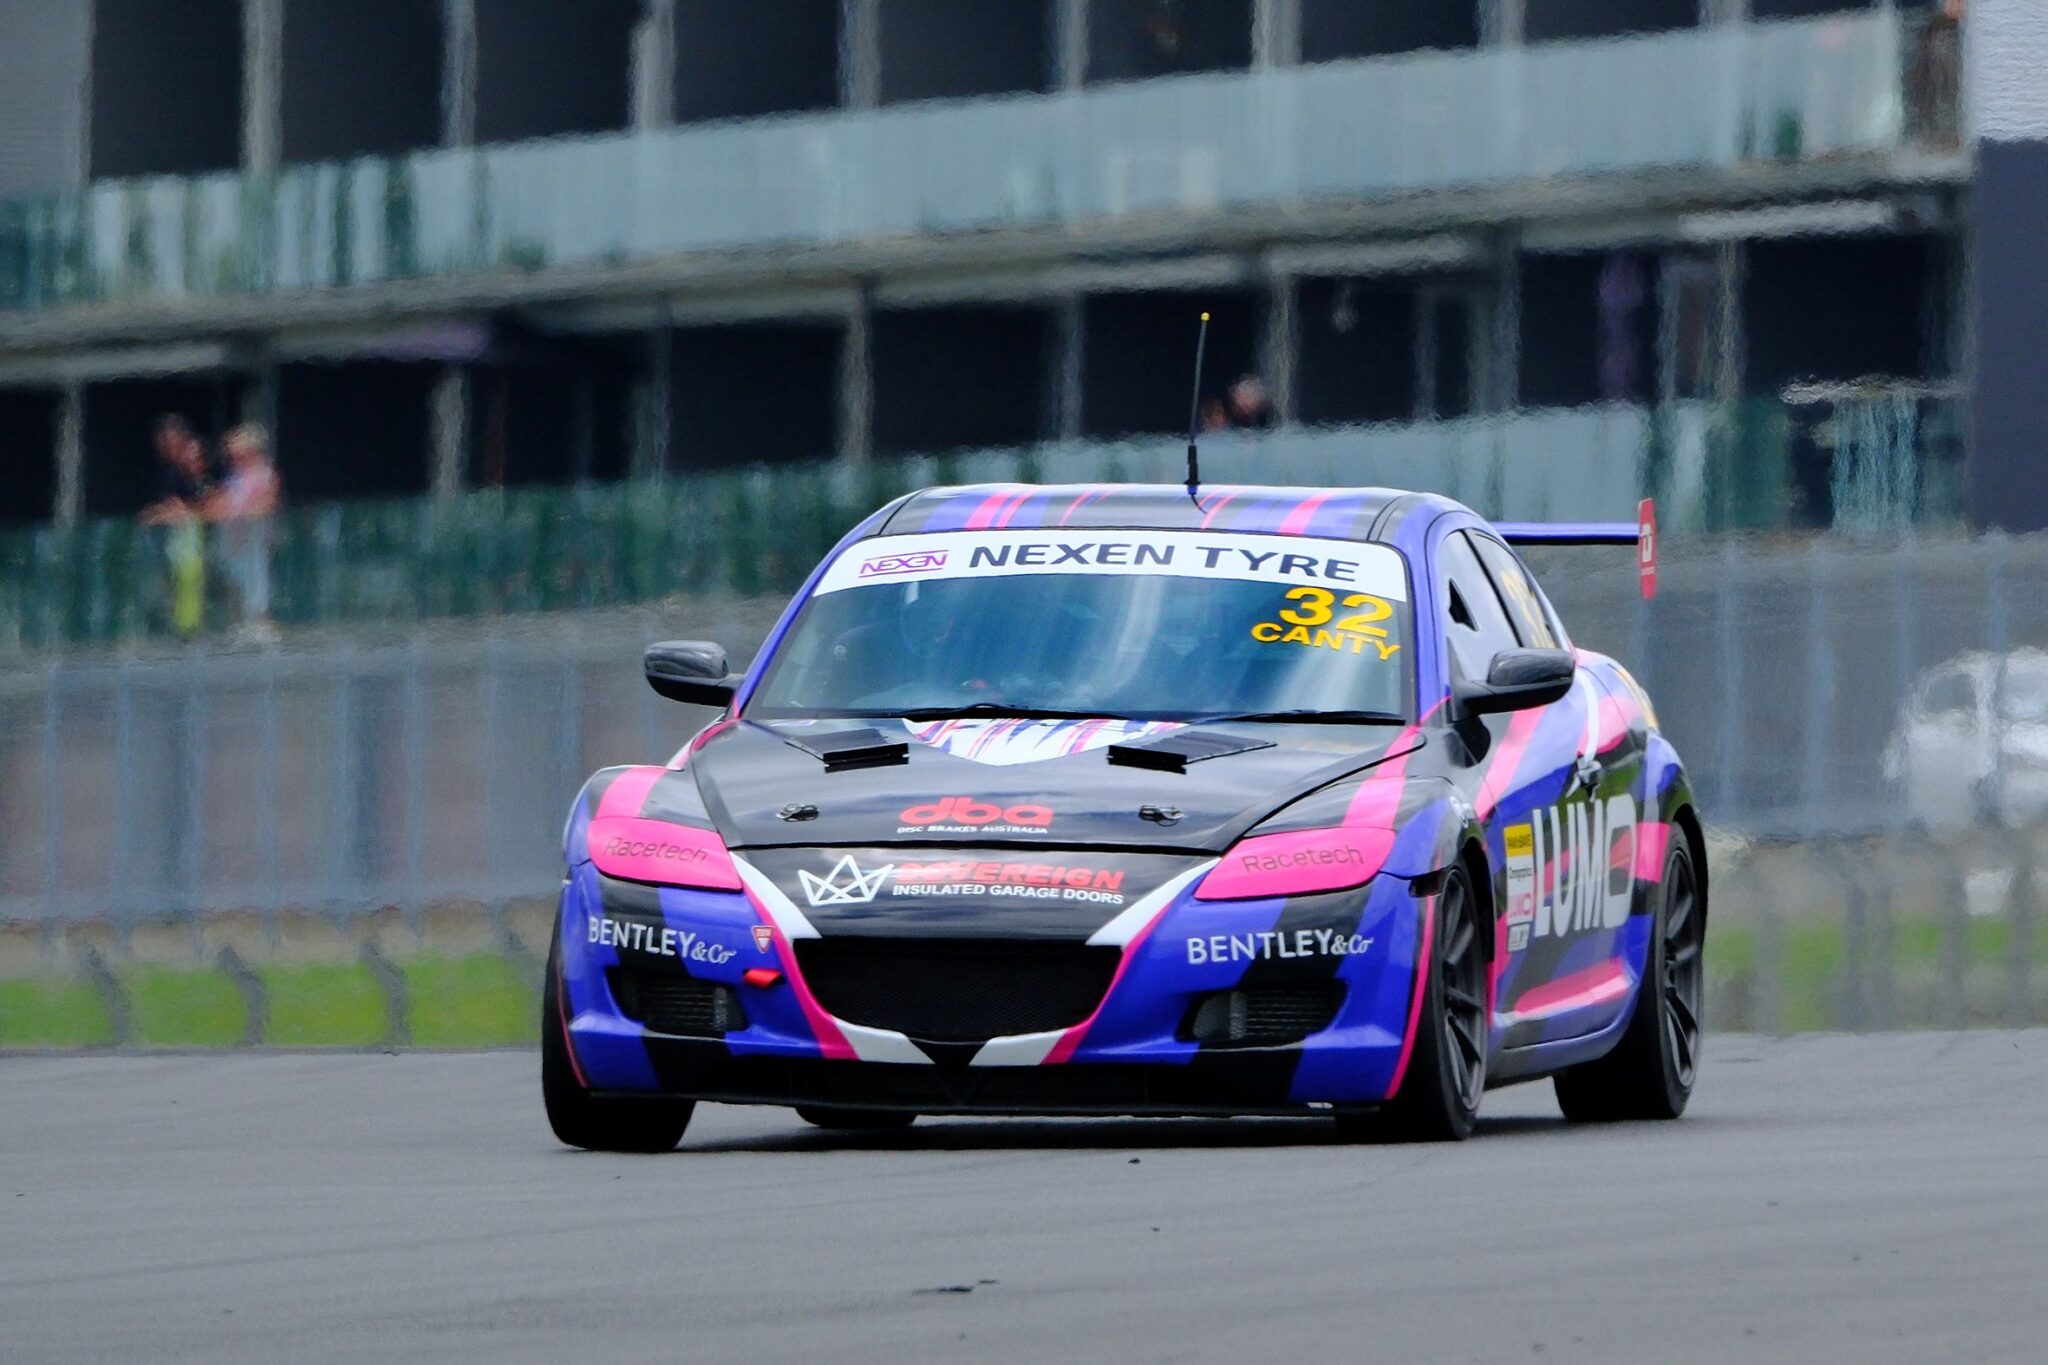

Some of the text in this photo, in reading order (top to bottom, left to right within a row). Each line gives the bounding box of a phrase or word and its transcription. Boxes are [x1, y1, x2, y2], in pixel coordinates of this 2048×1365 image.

[860, 552, 948, 575] NEXEN
[968, 543, 1360, 583] NEXEN TYRE
[1279, 586, 1393, 638] 32
[1251, 622, 1401, 661] CANTY
[900, 796, 1053, 826] dba
[897, 824, 1049, 834] DISC BRAKES AUSTRALIA
[604, 836, 709, 864] Racetech
[1242, 845, 1364, 873] Racetech
[1532, 793, 1637, 938] LUMO
[893, 884, 1125, 905] INSULATED GARAGE DOORS
